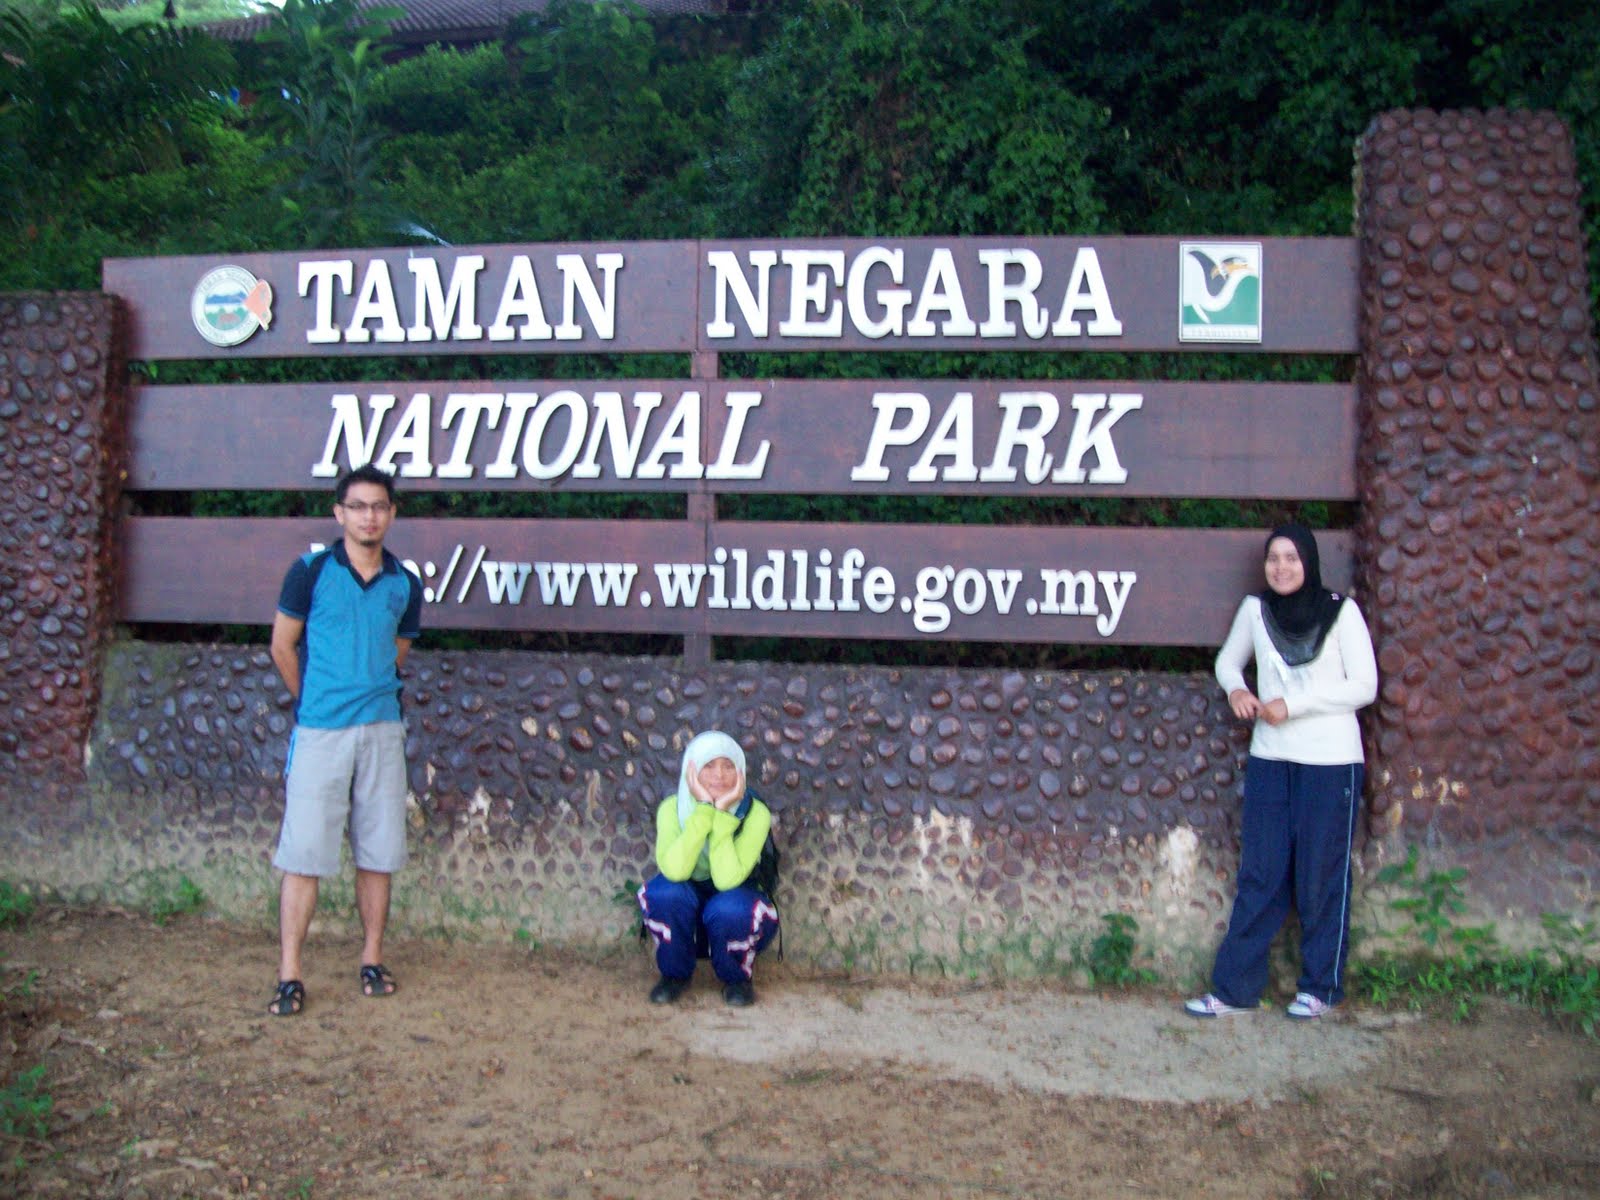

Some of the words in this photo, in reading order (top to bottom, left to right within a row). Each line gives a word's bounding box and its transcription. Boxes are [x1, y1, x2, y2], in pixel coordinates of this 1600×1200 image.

[297, 251, 625, 345] TAMAN
[705, 245, 1124, 340] NEGARA
[311, 390, 772, 480] NATIONAL
[850, 392, 1144, 485] PARK
[310, 542, 1138, 638] ://www.wildlife.gov.my
